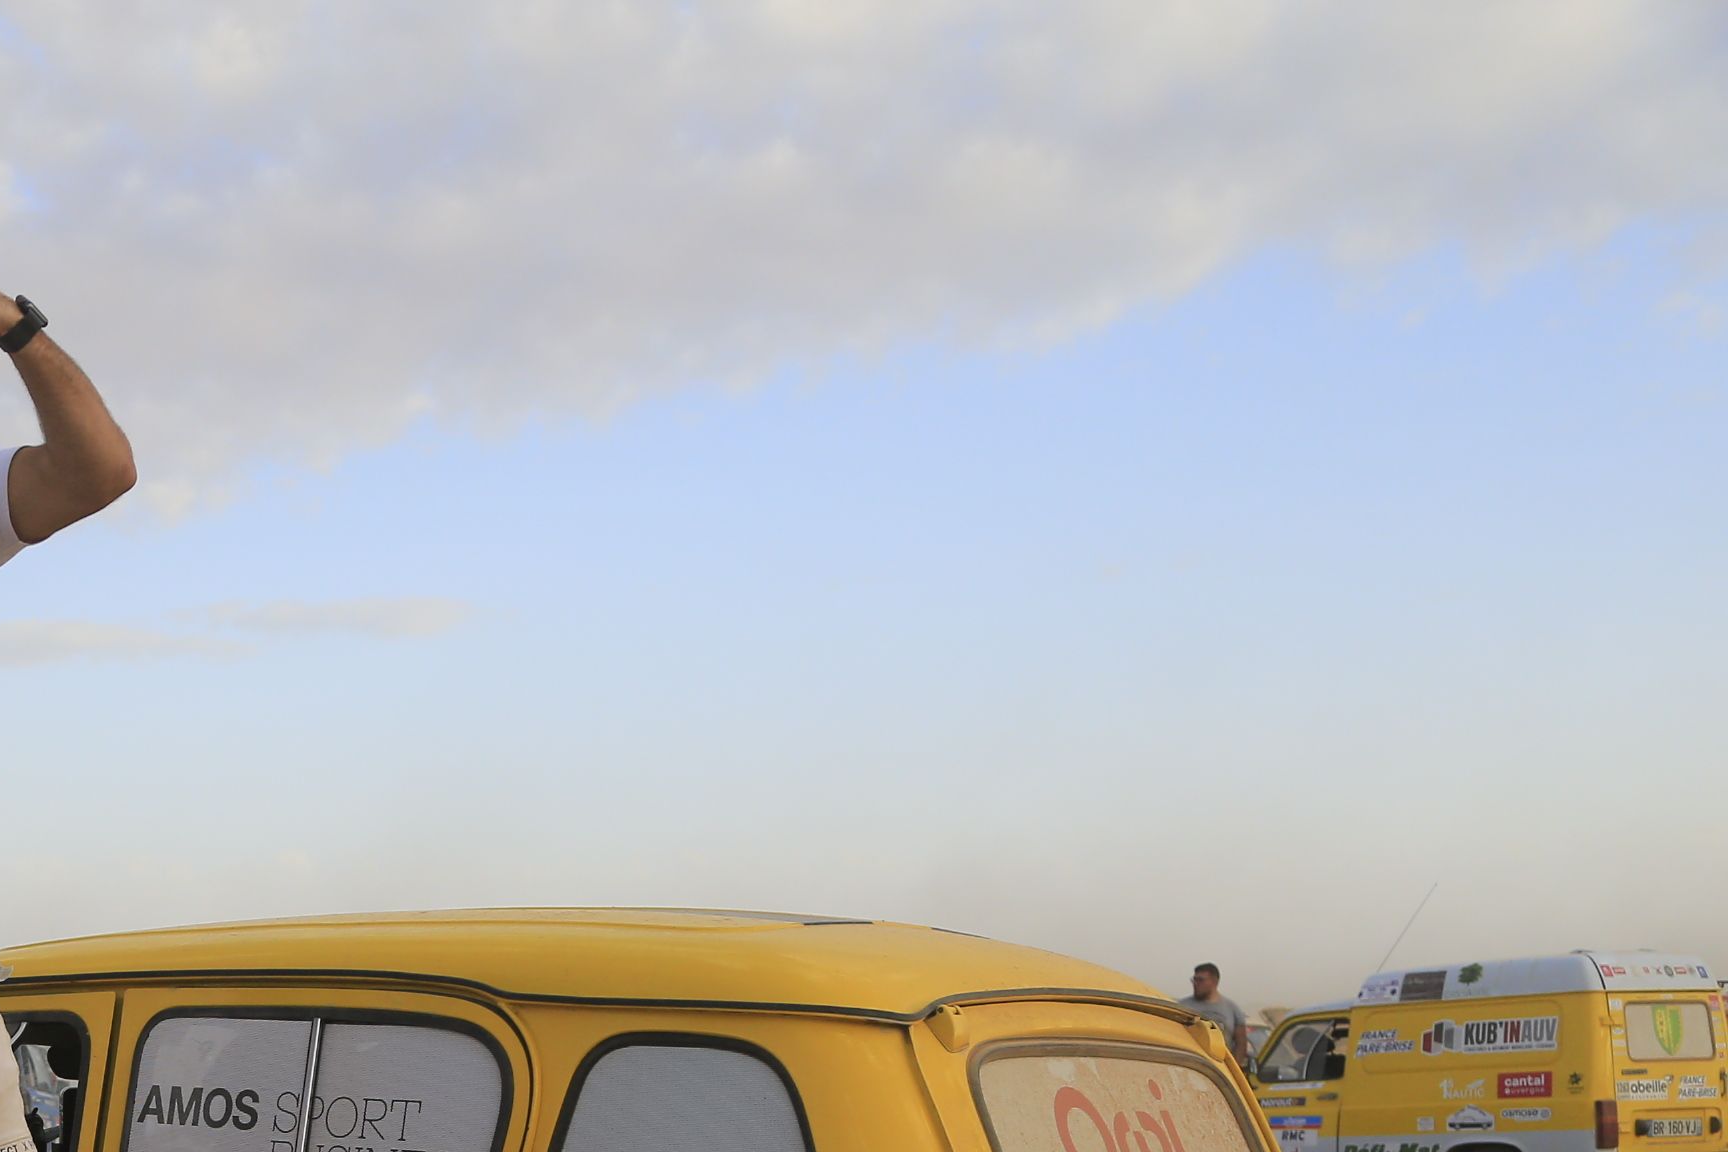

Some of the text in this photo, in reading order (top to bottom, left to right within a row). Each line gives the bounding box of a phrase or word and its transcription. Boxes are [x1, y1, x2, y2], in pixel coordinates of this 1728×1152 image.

[1361, 1029, 1397, 1040] FRANCE
[1504, 1074, 1545, 1086] cantal
[1630, 1080, 1667, 1094] abeille
[137, 1085, 422, 1141] AMOS SPORT
[1281, 1131, 1305, 1141] RMC
